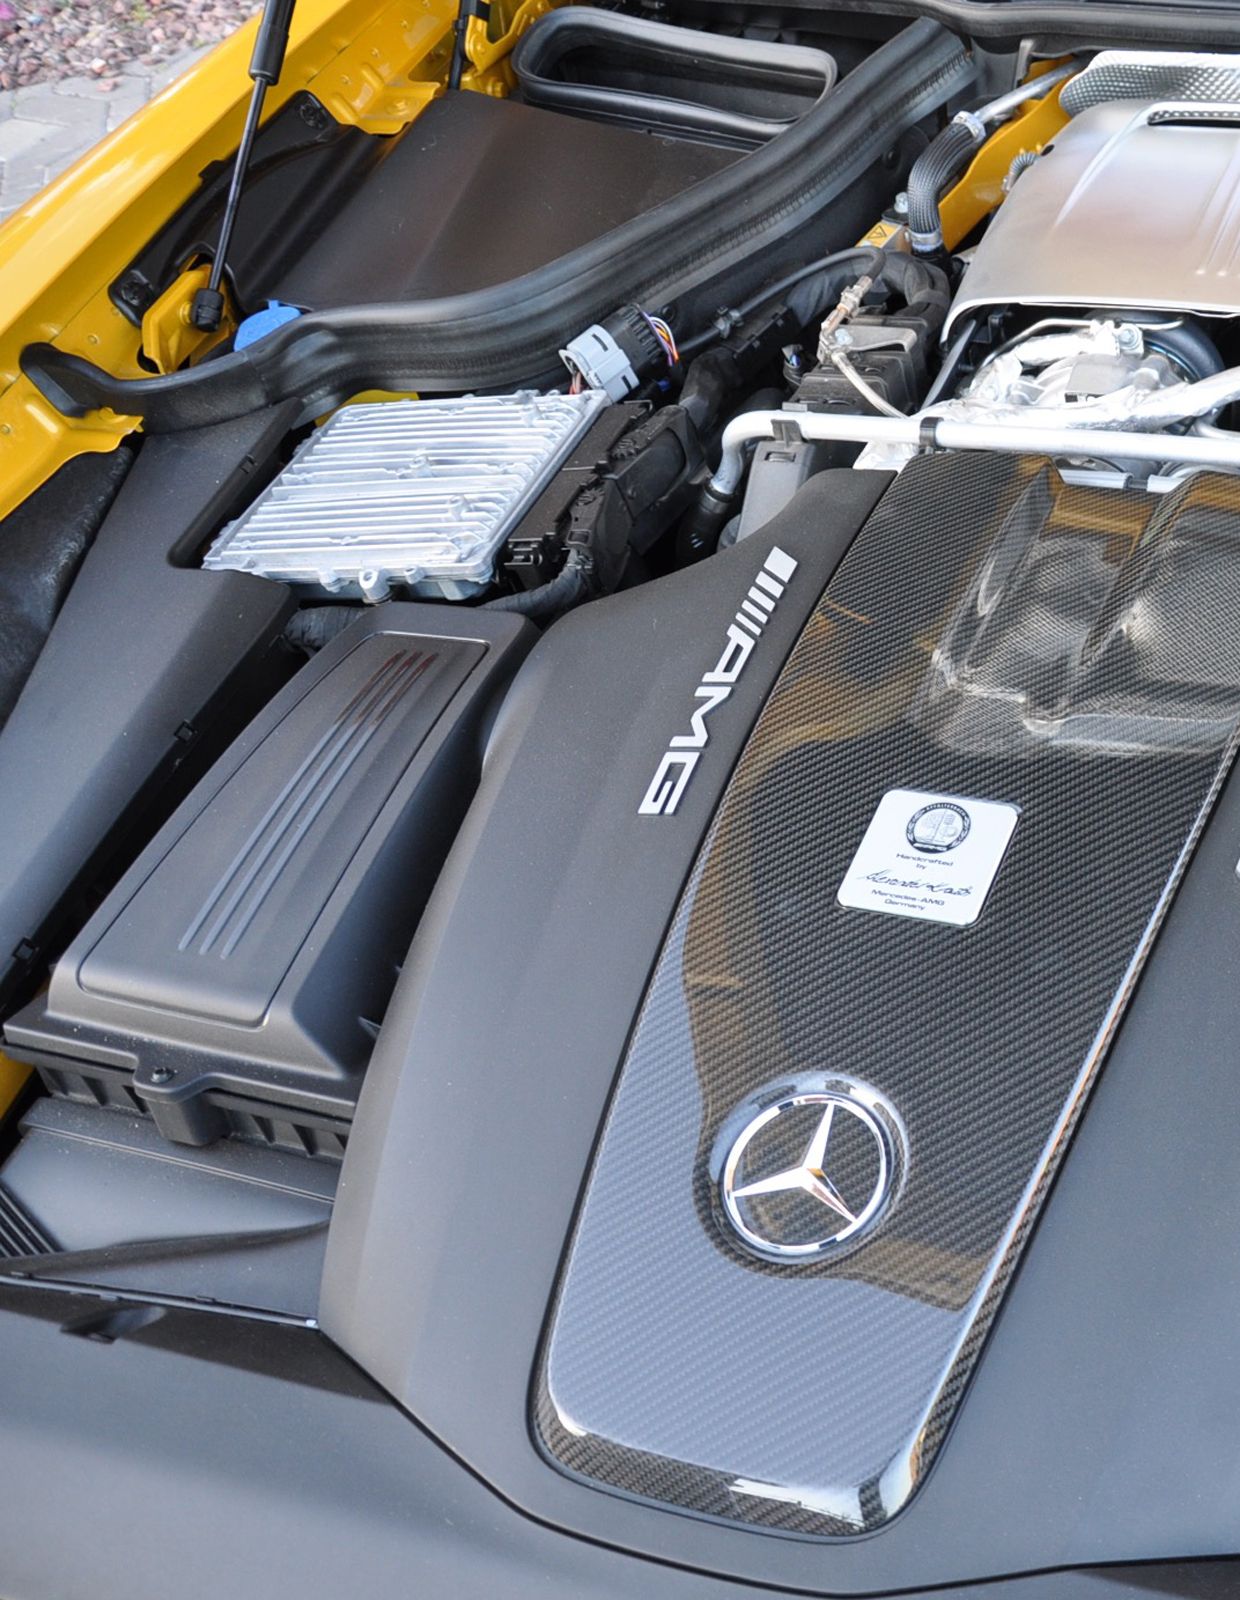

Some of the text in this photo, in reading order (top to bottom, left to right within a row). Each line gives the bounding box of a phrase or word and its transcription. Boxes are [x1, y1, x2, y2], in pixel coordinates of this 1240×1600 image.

[896, 853, 954, 867] Handcrafted
[871, 889, 945, 906] Mercedes-AMG
[884, 899, 925, 911] Germany
